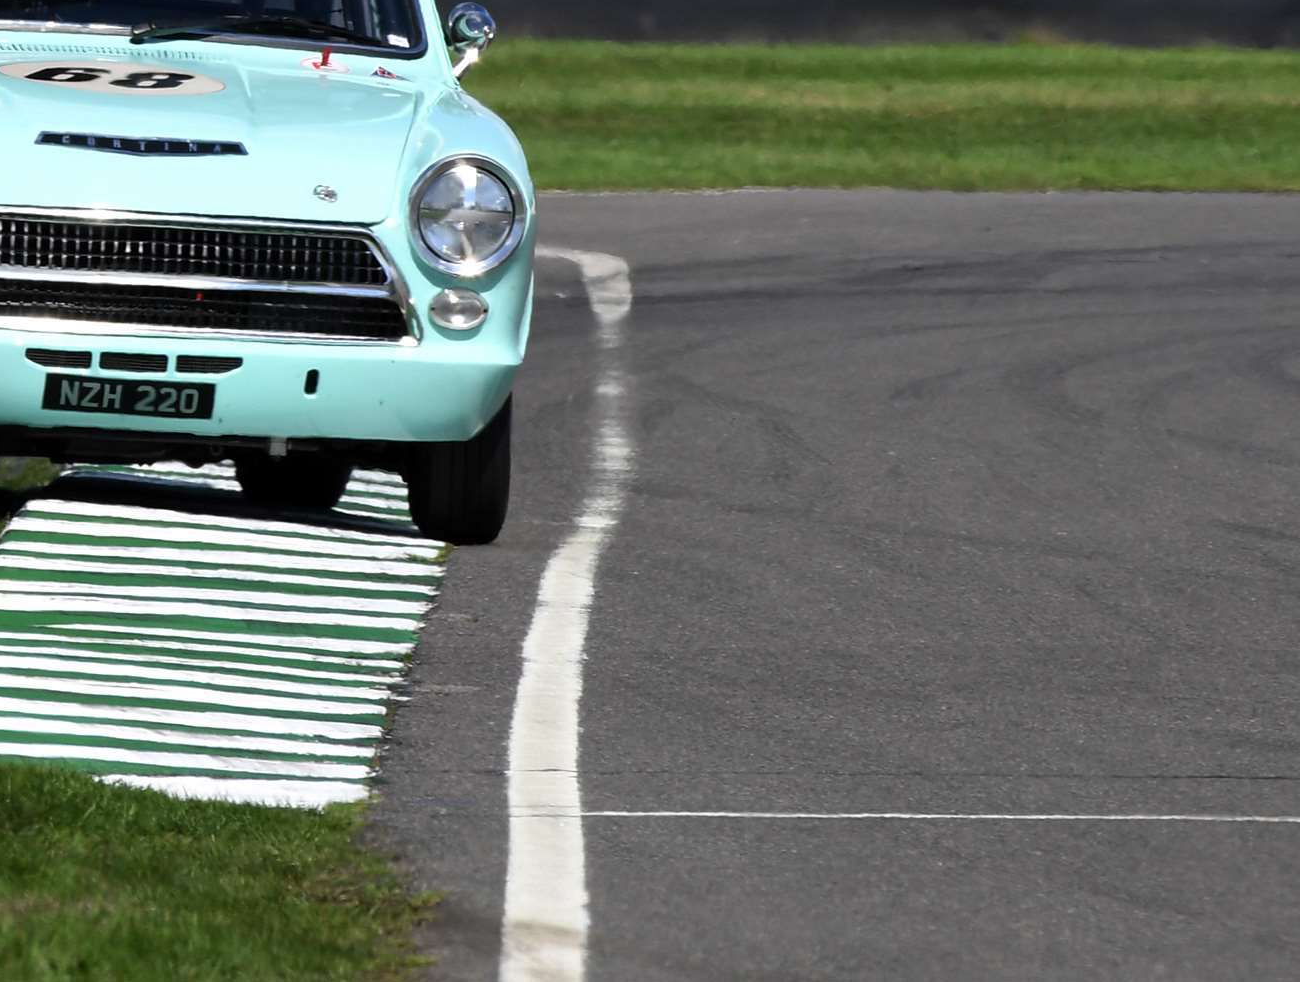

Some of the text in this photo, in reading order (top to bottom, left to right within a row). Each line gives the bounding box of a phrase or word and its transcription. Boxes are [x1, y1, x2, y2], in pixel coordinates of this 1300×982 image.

[24, 66, 195, 89] 68
[61, 135, 222, 153] CORTINA
[59, 379, 200, 414] NZH 220
